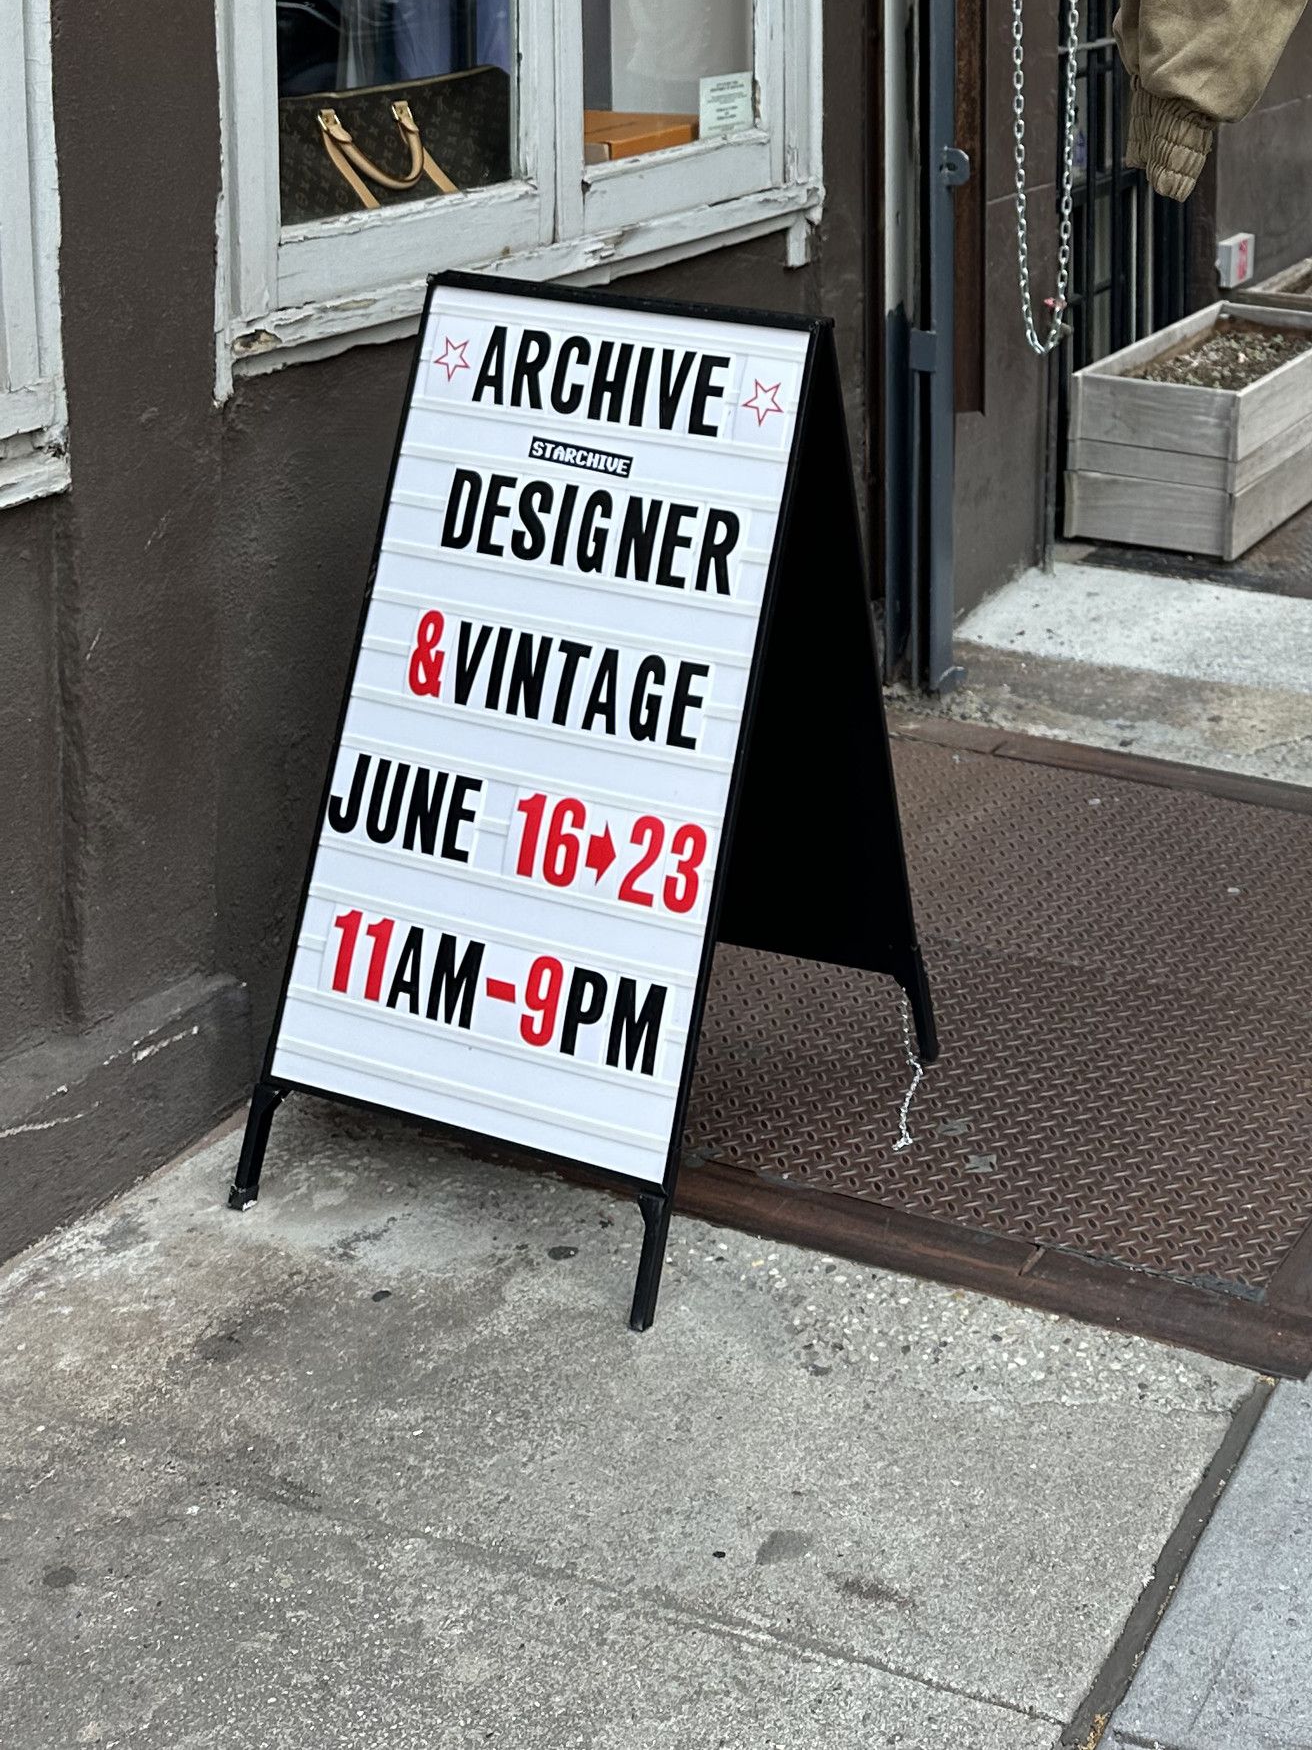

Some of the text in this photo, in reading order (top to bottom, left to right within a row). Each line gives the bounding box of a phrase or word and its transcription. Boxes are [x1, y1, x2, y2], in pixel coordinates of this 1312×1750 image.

[472, 325, 731, 438] ARCHIVE
[531, 440, 631, 476] STARCHIVE
[441, 468, 740, 596] DESIGNER
[328, 752, 483, 864] JUNE
[330, 908, 669, 1077] 11AM-9PM
